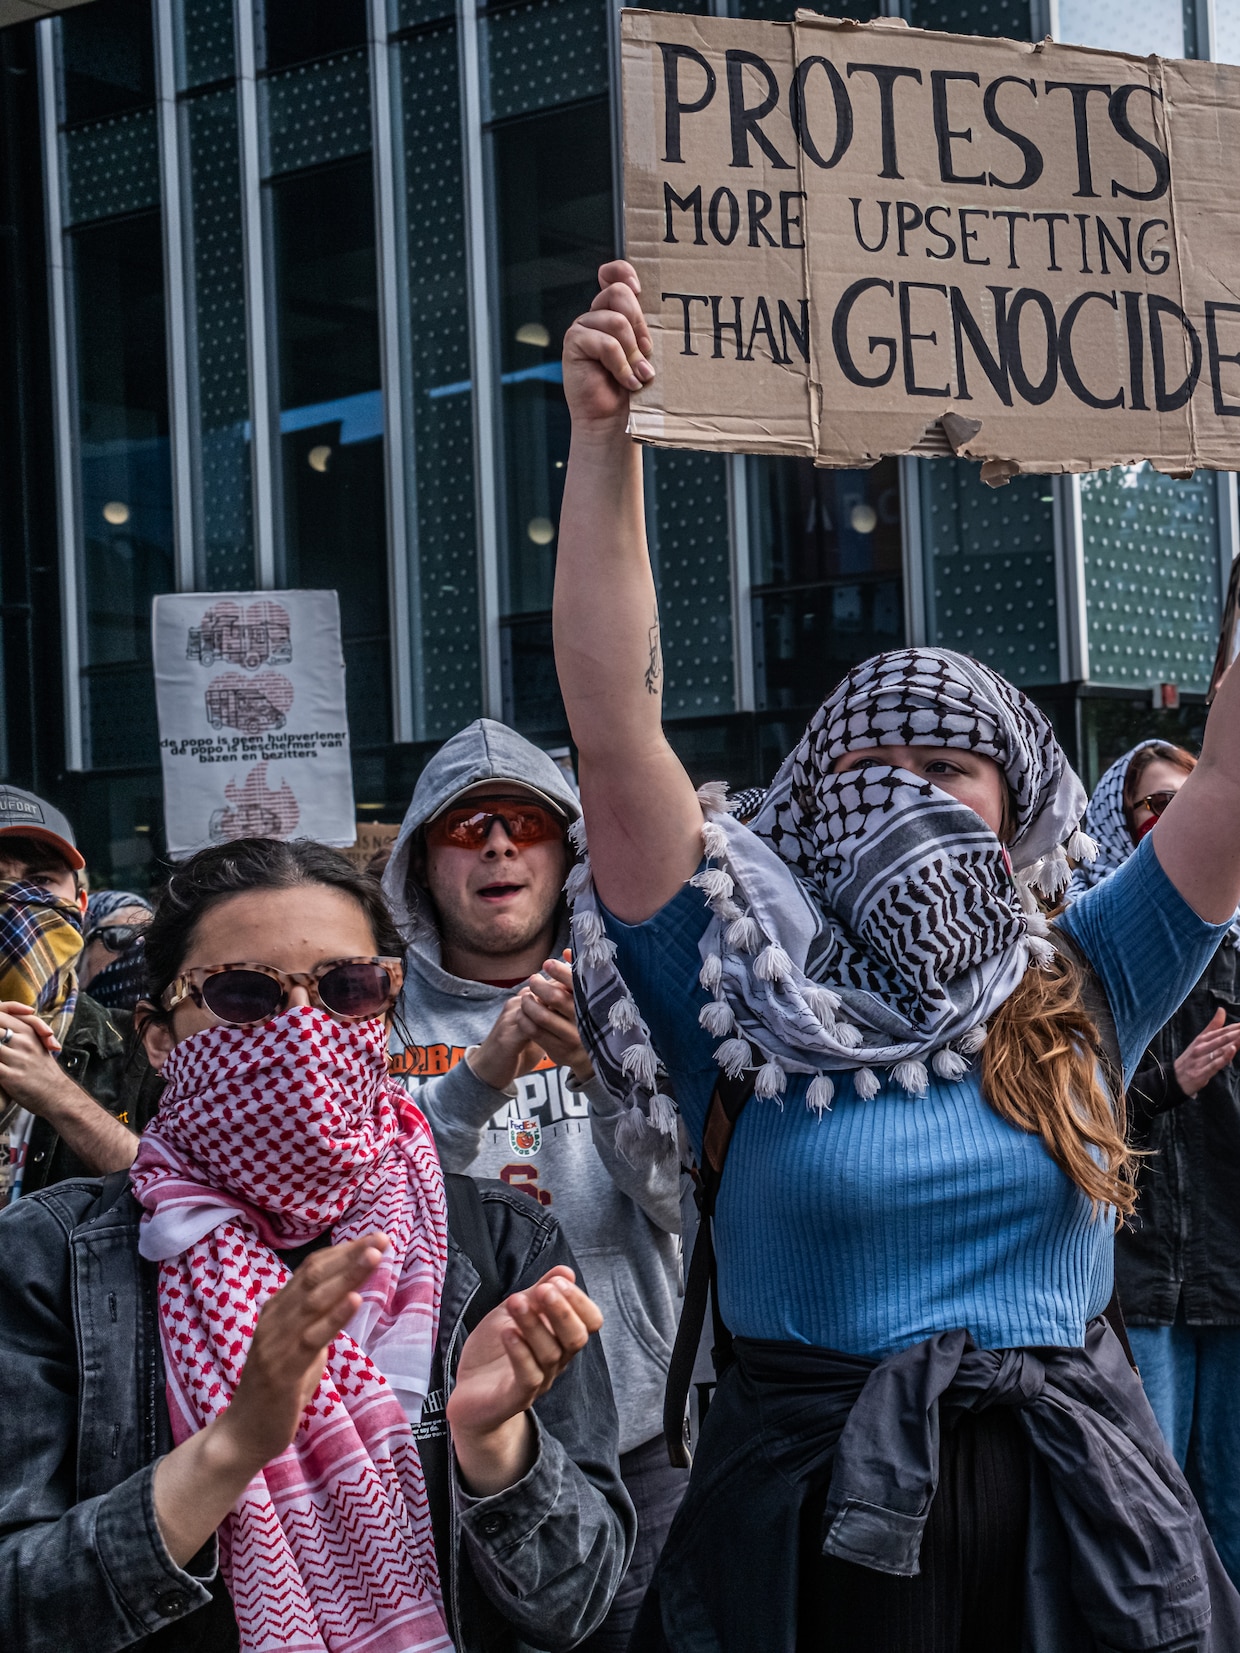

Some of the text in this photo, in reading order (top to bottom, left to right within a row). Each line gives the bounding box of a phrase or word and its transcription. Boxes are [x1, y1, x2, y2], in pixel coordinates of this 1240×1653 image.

[656, 42, 1171, 201] PROTESTS
[662, 182, 1171, 276] MORE UPSETTING
[661, 291, 811, 365] THAN
[159, 731, 347, 749] de popo is geen hulpverlener
[170, 740, 342, 756] de popo is beschermer van
[199, 749, 318, 763] bazen en bezitters
[510, 1120, 537, 1131] FedEx
